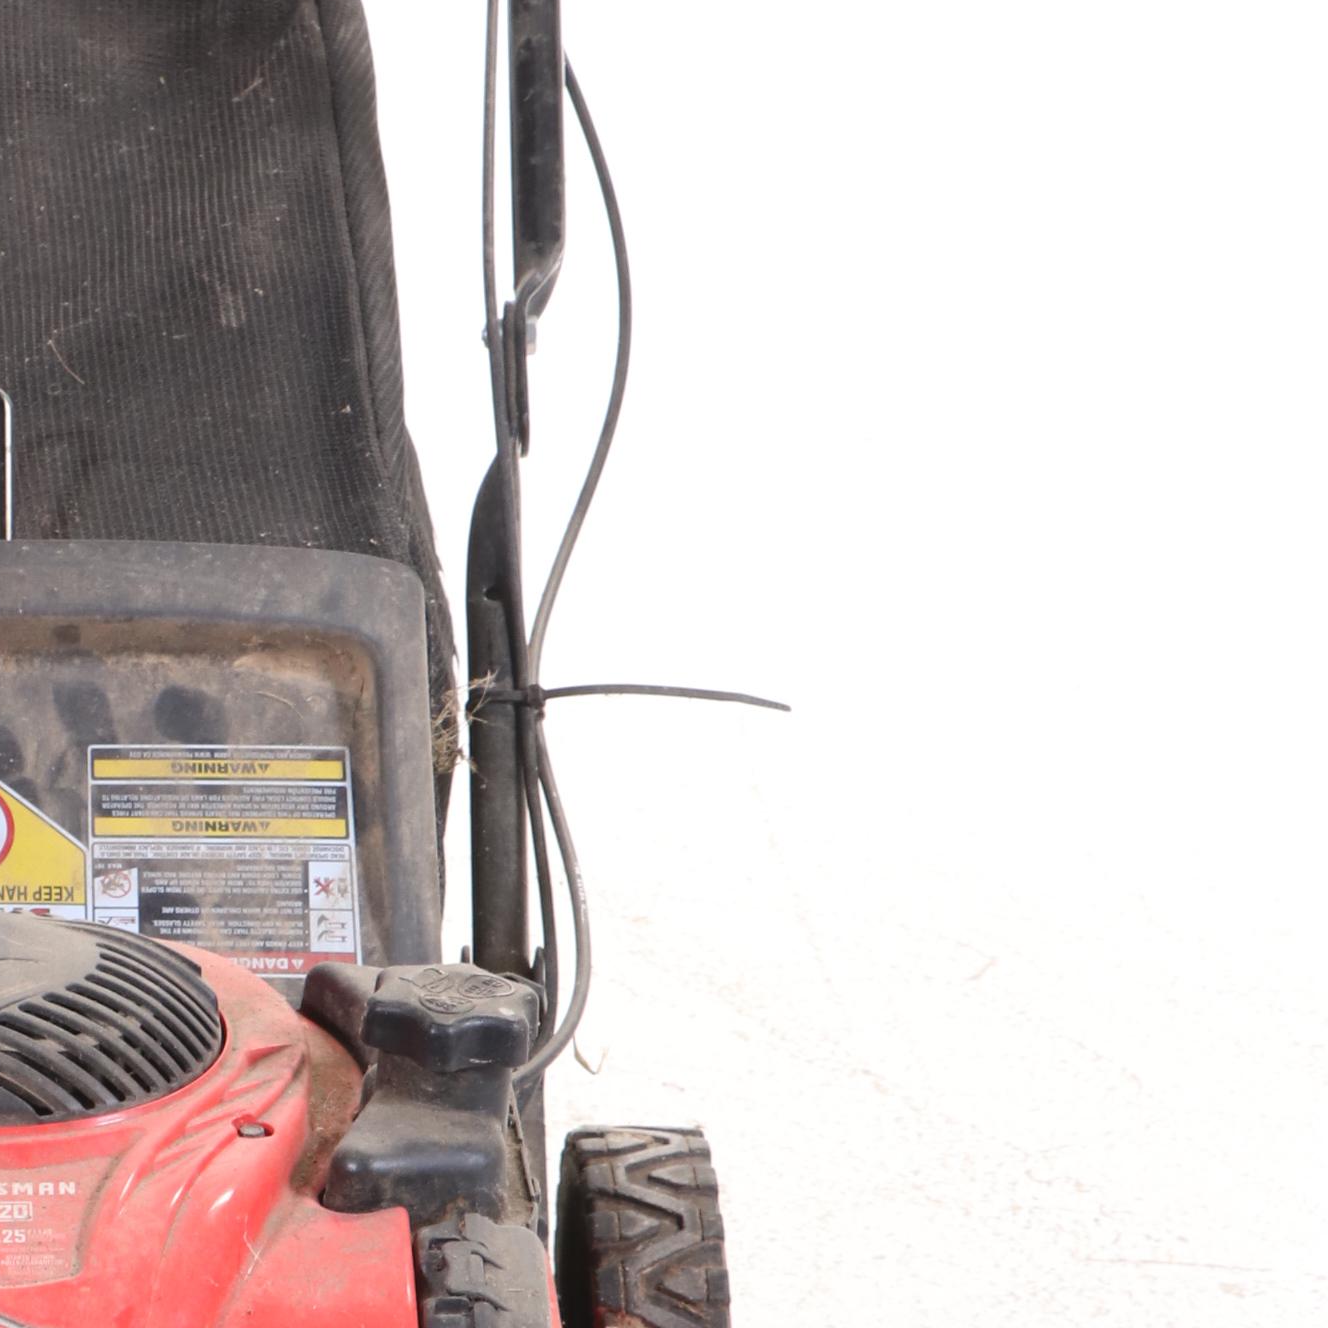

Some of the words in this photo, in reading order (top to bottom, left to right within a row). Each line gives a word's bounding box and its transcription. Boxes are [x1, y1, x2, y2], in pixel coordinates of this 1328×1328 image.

[171, 763, 257, 774] WARNING
[171, 821, 258, 832] WARNING
[33, 885, 74, 902] KEEP
